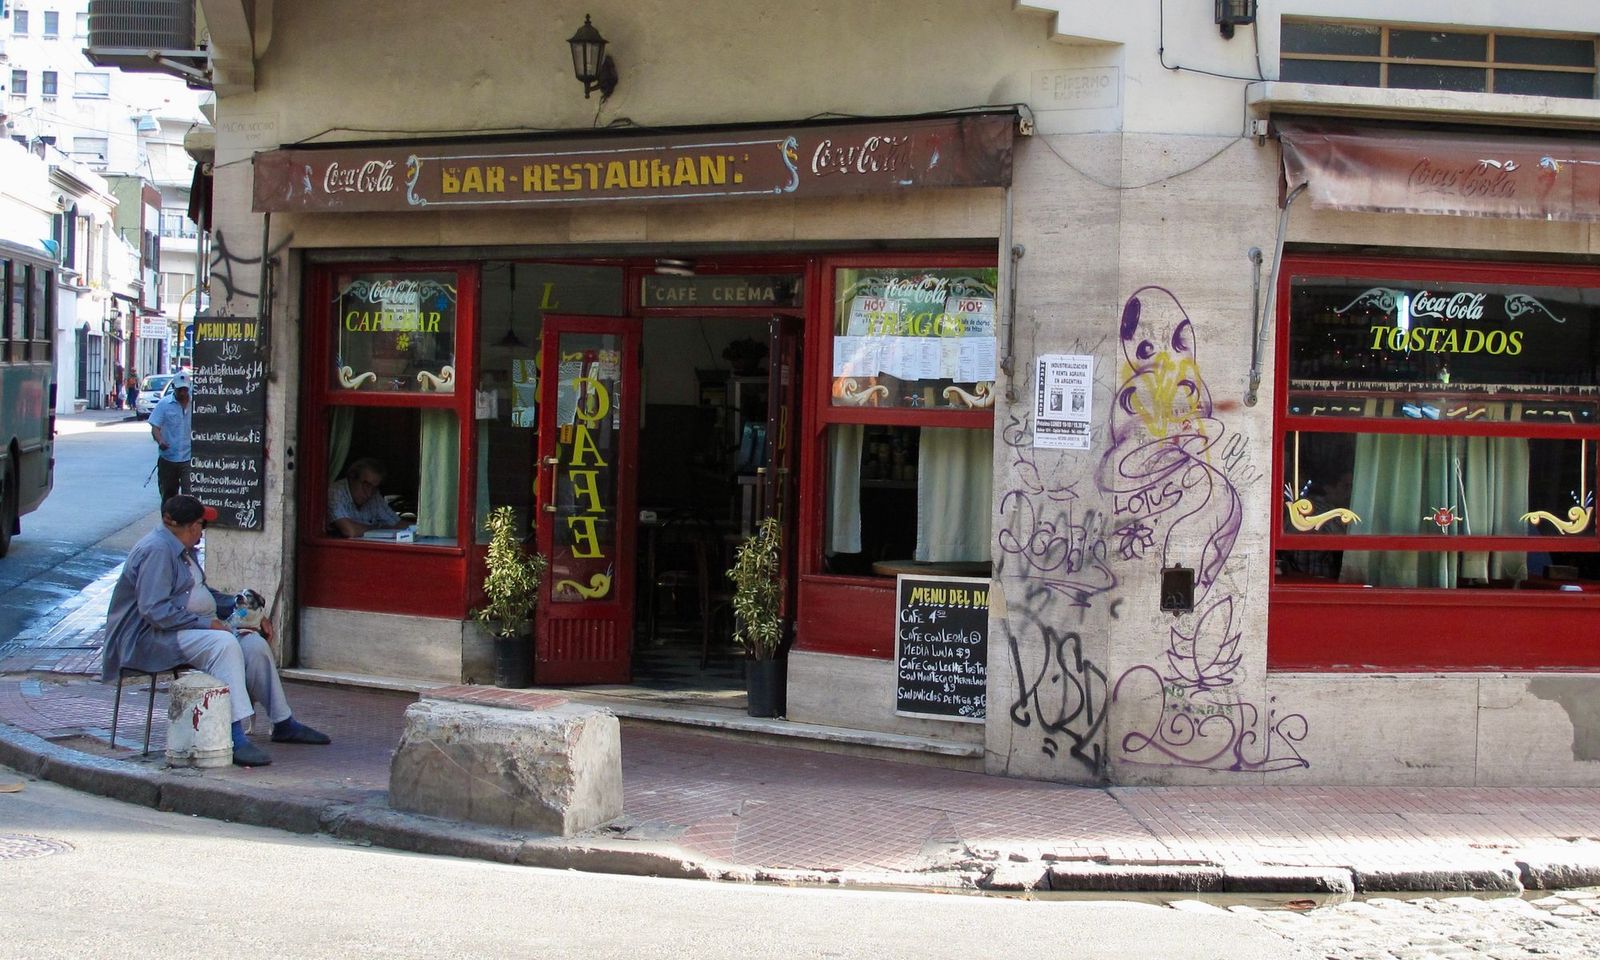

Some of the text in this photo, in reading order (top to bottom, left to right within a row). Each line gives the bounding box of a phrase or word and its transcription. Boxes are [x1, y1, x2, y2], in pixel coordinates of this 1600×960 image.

[323, 160, 396, 194] Coca-Cola
[369, 280, 419, 303] Coca-Cola
[656, 287, 776, 301] CAFE CREMA
[884, 277, 949, 304] Coca-Cola
[863, 299, 886, 311] HOY
[958, 300, 983, 312] HOY
[1410, 290, 1487, 320] Coca-Cola
[195, 322, 225, 343] MENU
[227, 323, 243, 341] DEL
[1370, 325, 1524, 355] TOSTADOS
[1114, 482, 1182, 515] LOTUS
[908, 587, 946, 607] MENU
[948, 589, 971, 609] DEL
